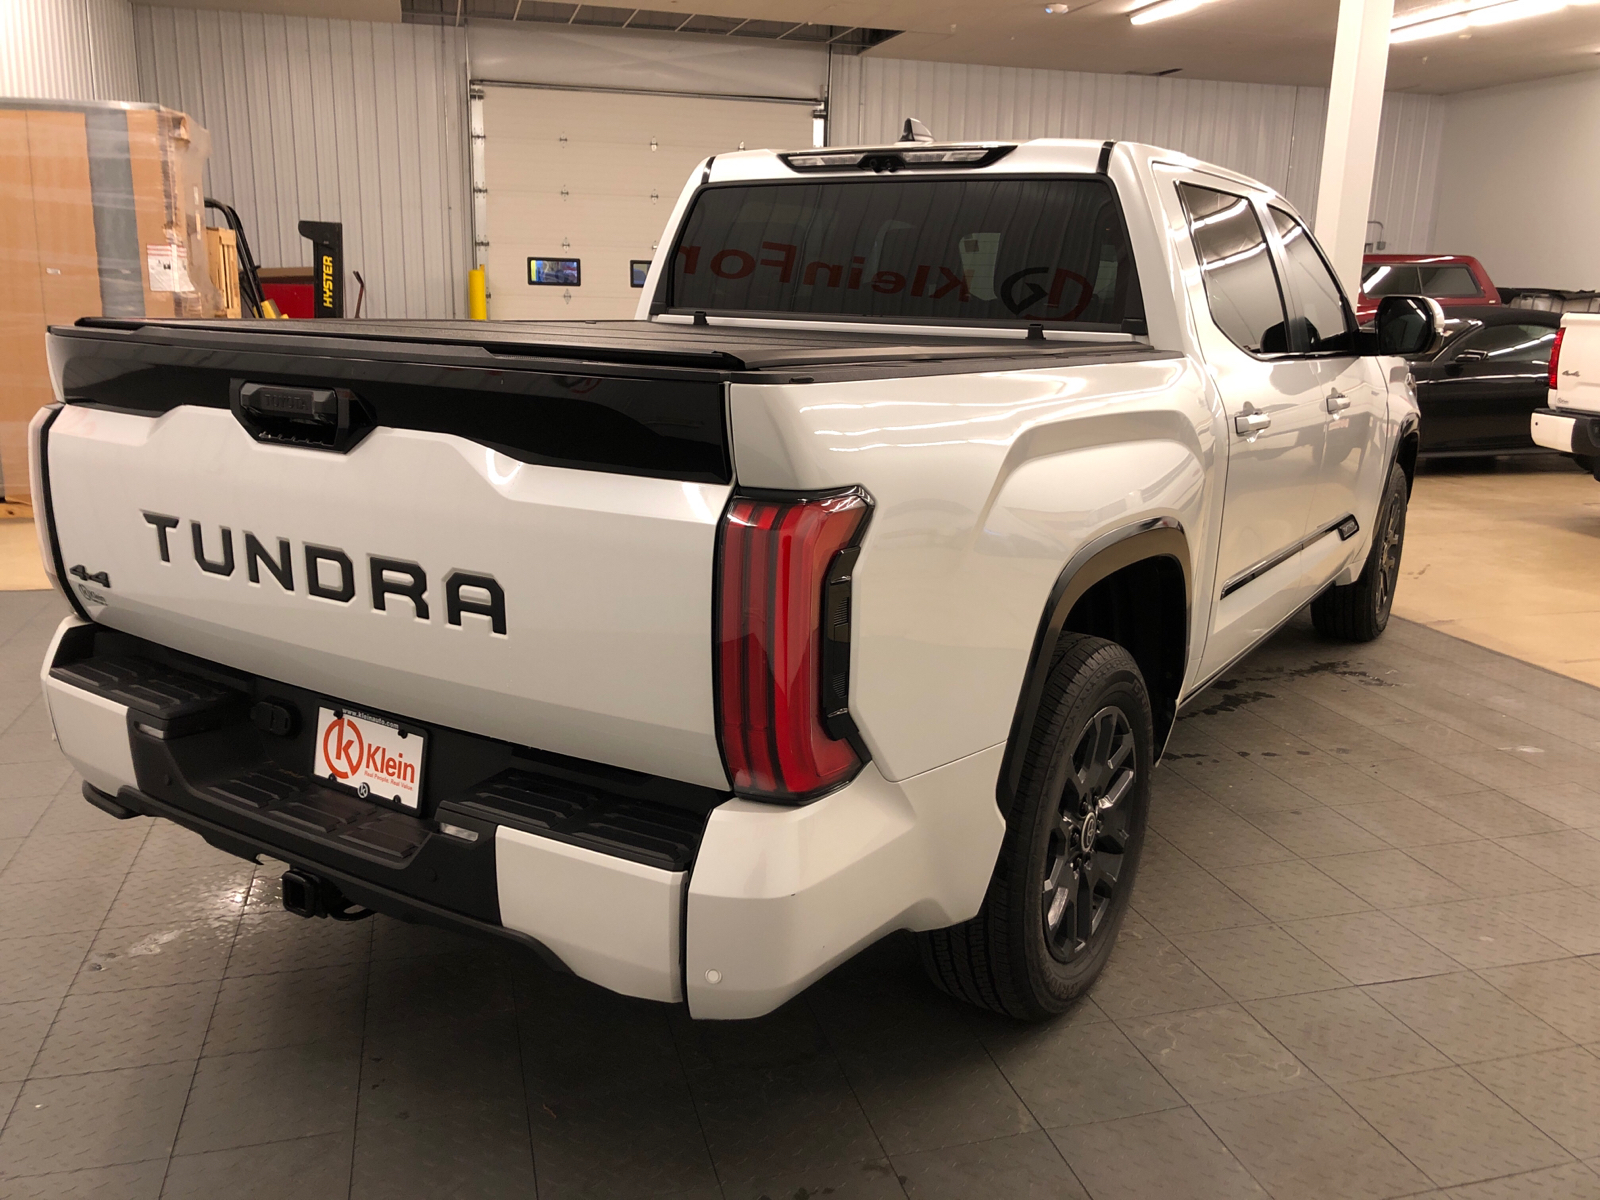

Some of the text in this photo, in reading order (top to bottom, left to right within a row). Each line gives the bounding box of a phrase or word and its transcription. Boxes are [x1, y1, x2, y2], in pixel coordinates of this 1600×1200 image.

[323, 255, 333, 308] HYSTER
[141, 510, 507, 638] TUNDRA
[342, 708, 399, 729] www.kleinauto.com
[366, 743, 415, 784] Klein
